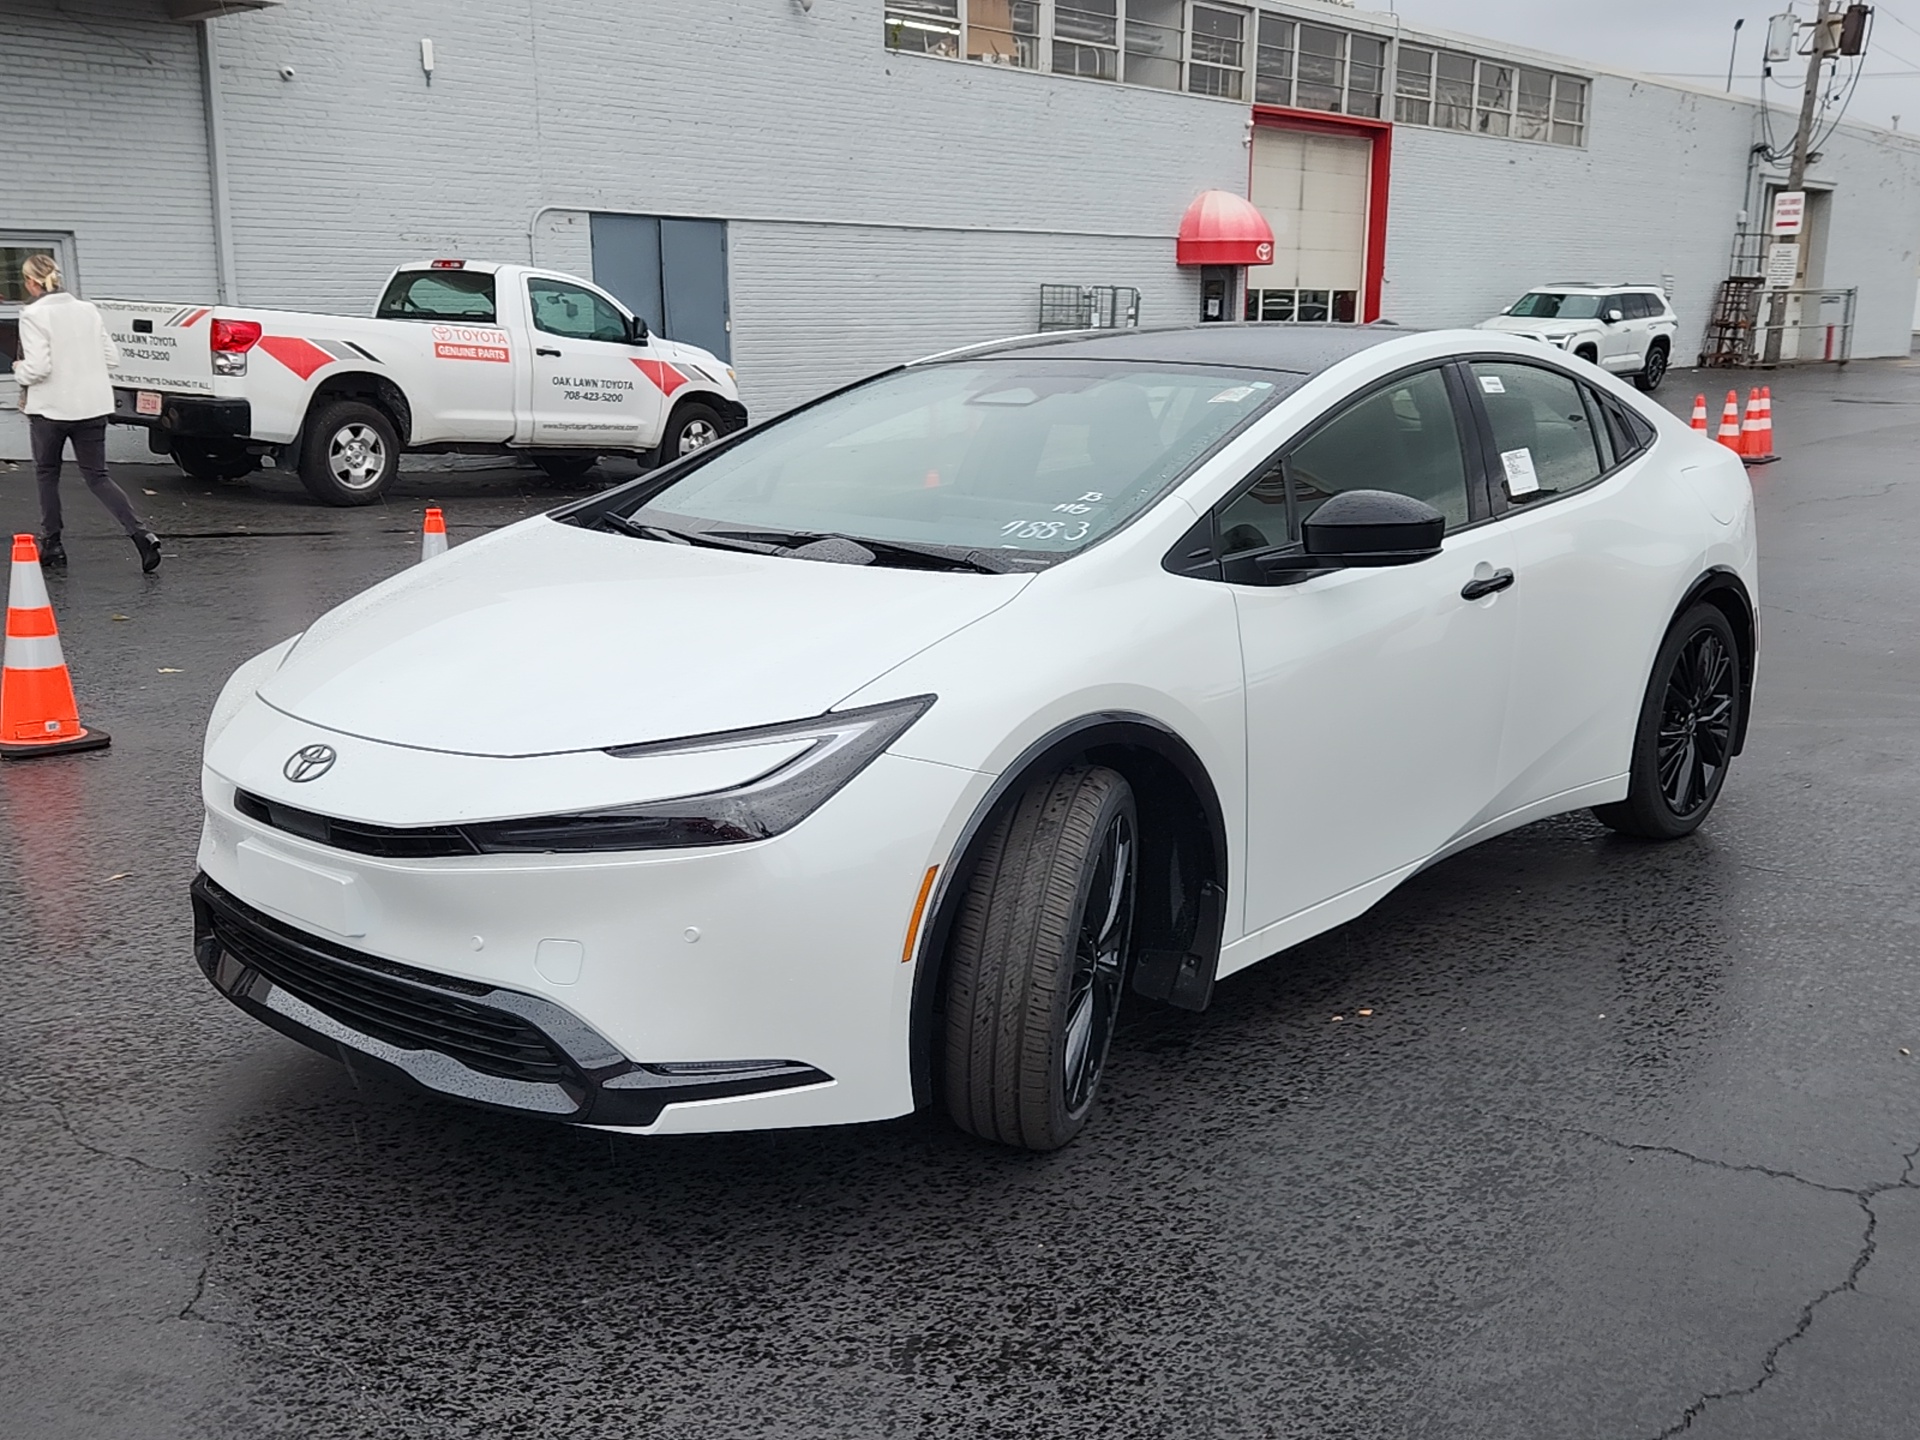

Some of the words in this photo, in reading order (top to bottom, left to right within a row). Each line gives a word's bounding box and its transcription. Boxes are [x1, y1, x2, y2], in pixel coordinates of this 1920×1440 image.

[111, 333, 126, 343] OAK
[127, 334, 148, 345] LAWN
[149, 336, 178, 348] TOYOTA
[453, 329, 508, 344] TOYOTA
[122, 347, 170, 361] 708-423-5200
[438, 345, 477, 357] GENUINE
[477, 348, 506, 360] PARTS
[552, 376, 571, 386] OAK
[573, 377, 598, 388] LAWN
[600, 379, 634, 390] TOYOTA
[564, 390, 623, 402] 708-423-5200
